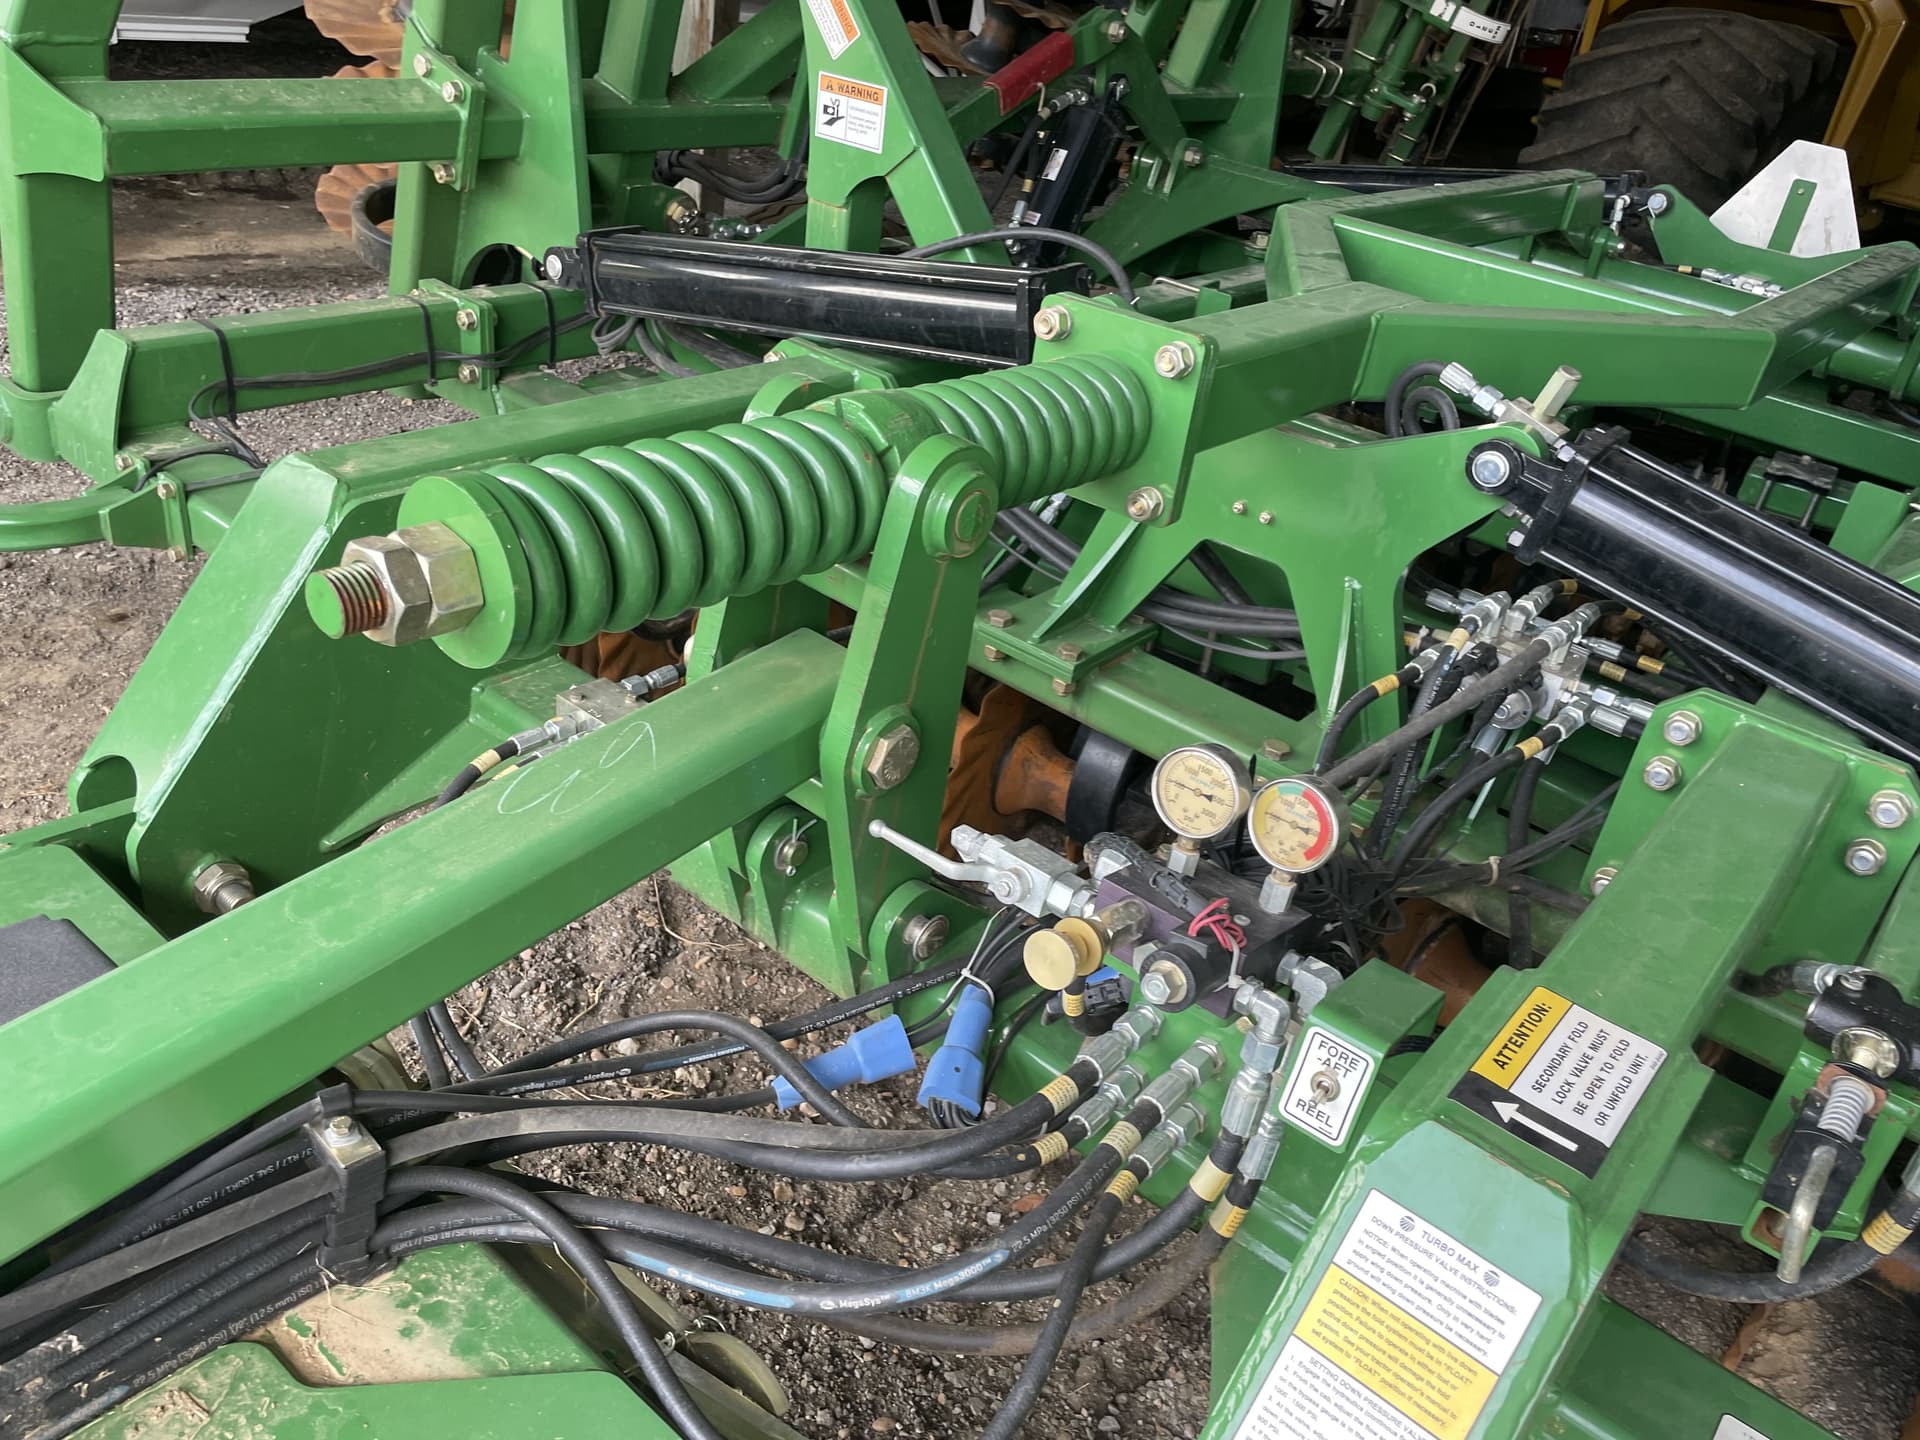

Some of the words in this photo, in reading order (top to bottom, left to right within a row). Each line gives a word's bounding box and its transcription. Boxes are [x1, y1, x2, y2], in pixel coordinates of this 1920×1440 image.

[838, 83, 878, 100] WARNING
[1318, 1040, 1359, 1069] FORE
[1491, 1001, 1550, 1068] ATTENTION:
[1531, 1043, 1572, 1092] SECONDARY
[1567, 1021, 1587, 1041] FOLD
[1552, 1080, 1574, 1103] LOCK
[1570, 1053, 1592, 1077] VALVE
[1588, 1029, 1609, 1051] MUST
[1574, 1102, 1587, 1114] BE
[1584, 1076, 1604, 1099] OPEN
[1601, 1062, 1613, 1073] TO
[1610, 1039, 1629, 1059] FOLD
[1594, 1112, 1609, 1126] OR
[1605, 1076, 1632, 1109] UNFOLD
[1628, 1053, 1646, 1073] UNIT.
[1296, 1099, 1334, 1127] REEL
[1363, 1228, 1389, 1248] NOTICE:
[1390, 1246, 1408, 1261] When
[1409, 1259, 1438, 1281] operating
[1439, 1279, 1467, 1300] machine
[1468, 1298, 1481, 1309] with
[1483, 1307, 1505, 1325] blades
[1371, 1216, 1393, 1233] DOWN
[1394, 1231, 1432, 1259] PRESSURE
[1435, 1257, 1458, 1275] VALVE
[1420, 1230, 1455, 1257] TURBO
[1456, 1253, 1479, 1273] MAX
[1347, 1258, 1369, 1275] ground
[1370, 1273, 1380, 1283] will
[1381, 1281, 1396, 1293] wing
[1397, 1291, 1414, 1306] down
[1415, 1304, 1443, 1325] pressure
[1444, 1323, 1453, 1332] be
[1353, 1248, 1368, 1261] apply
[1370, 1260, 1384, 1272] wing
[1386, 1270, 1402, 1284] down
[1436, 1304, 1451, 1317] Only
[1452, 1314, 1459, 1322] in
[1460, 1320, 1474, 1332] very
[1476, 1330, 1491, 1343] hard
[1309, 1358, 1338, 1381] SETTING
[1339, 1379, 1362, 1398] DOWN
[1363, 1396, 1401, 1426] PRESSURE
